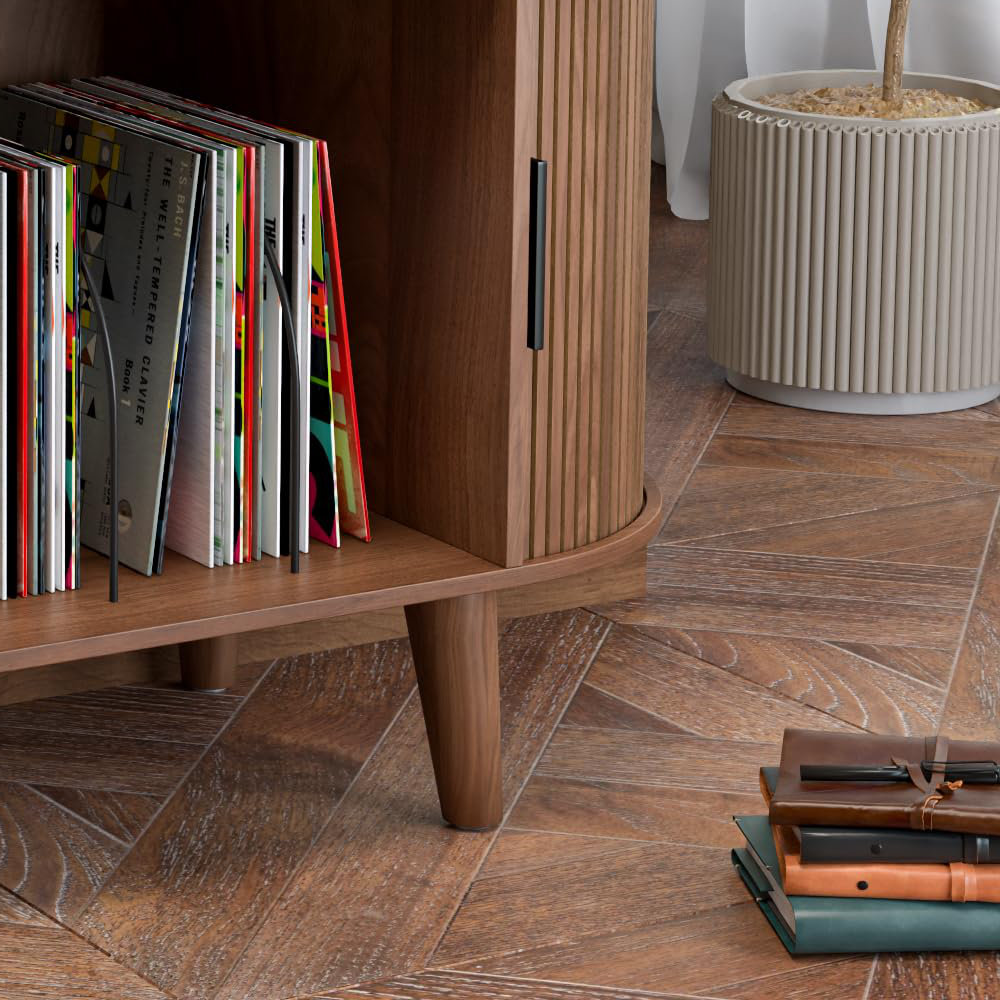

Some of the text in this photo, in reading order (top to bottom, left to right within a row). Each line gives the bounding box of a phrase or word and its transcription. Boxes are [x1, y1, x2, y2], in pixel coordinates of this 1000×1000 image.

[162, 157, 174, 188] THE
[173, 193, 186, 239] BACH
[122, 358, 134, 394] Book
[135, 355, 150, 426] CLAVIER
